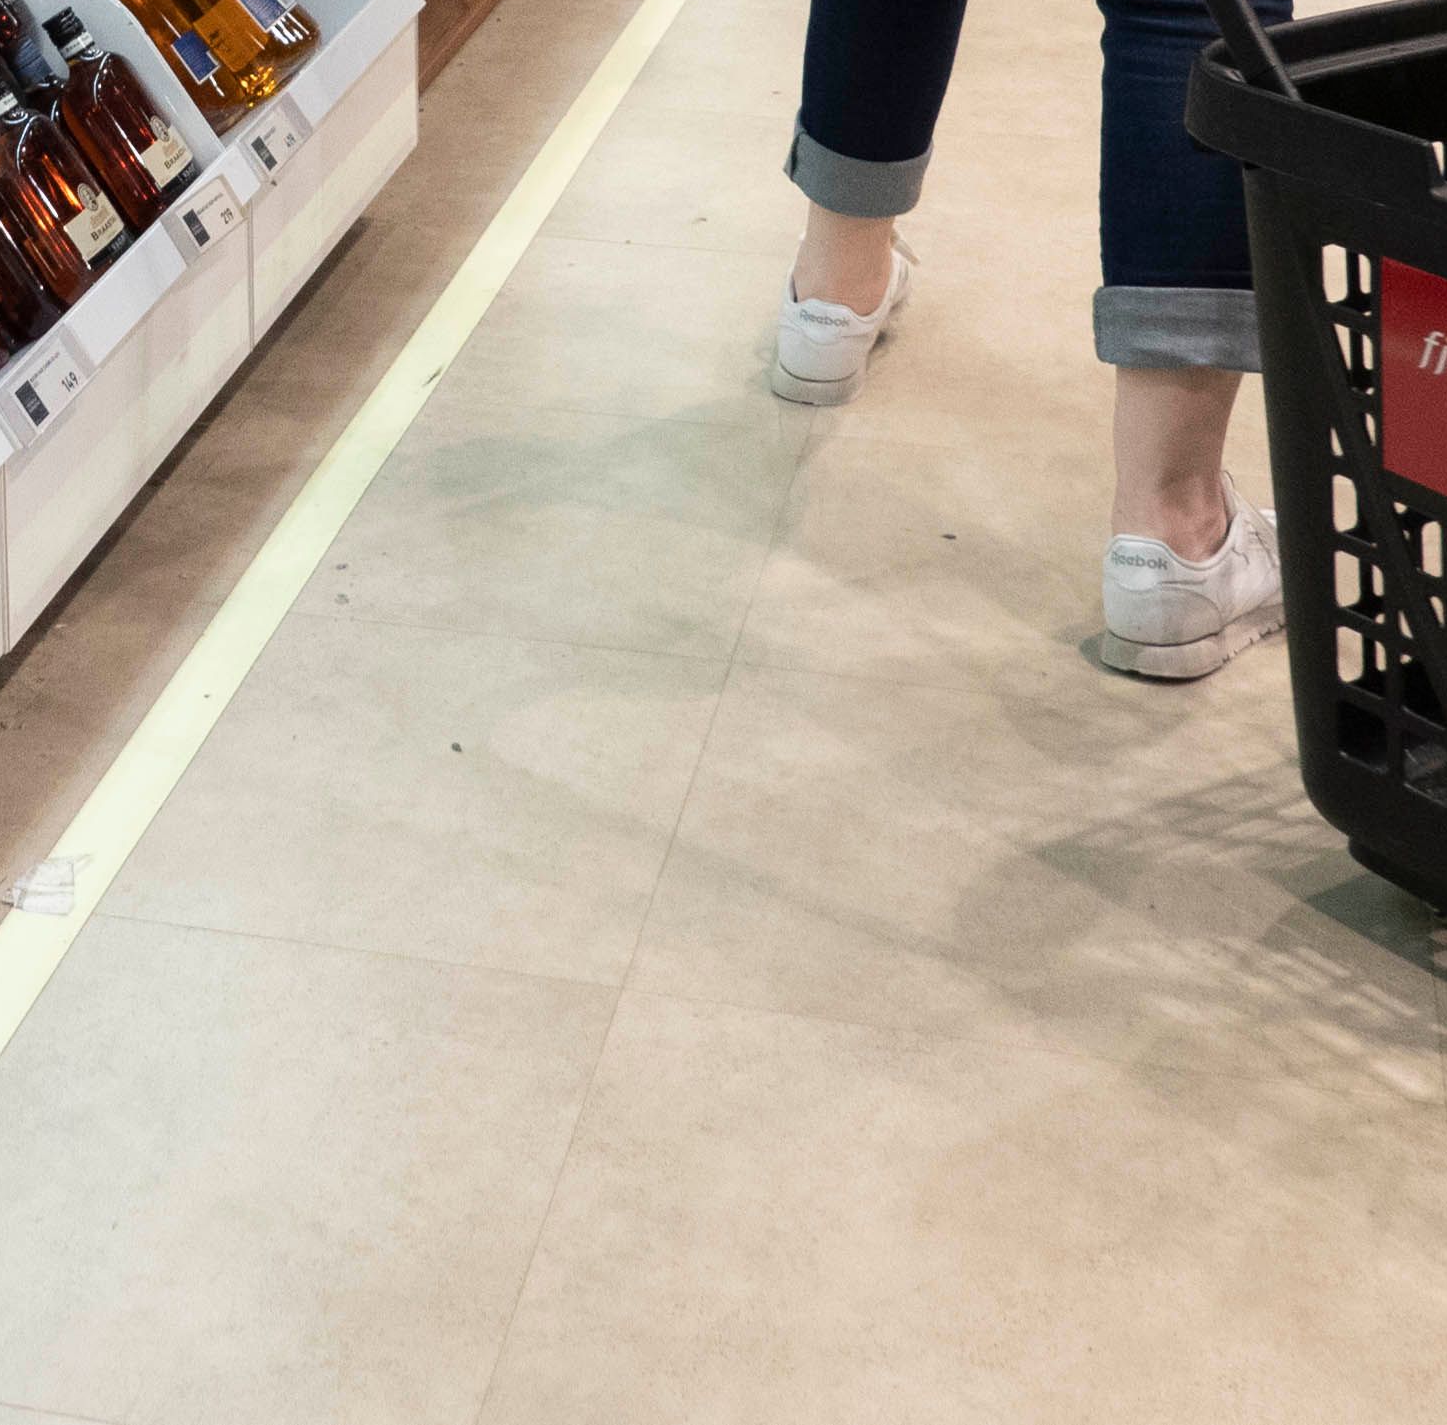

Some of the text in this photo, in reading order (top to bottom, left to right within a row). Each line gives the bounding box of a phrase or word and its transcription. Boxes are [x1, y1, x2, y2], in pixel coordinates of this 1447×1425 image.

[799, 308, 851, 328] Reebok
[61, 371, 80, 392] 149
[1110, 549, 1170, 572] Reebok
